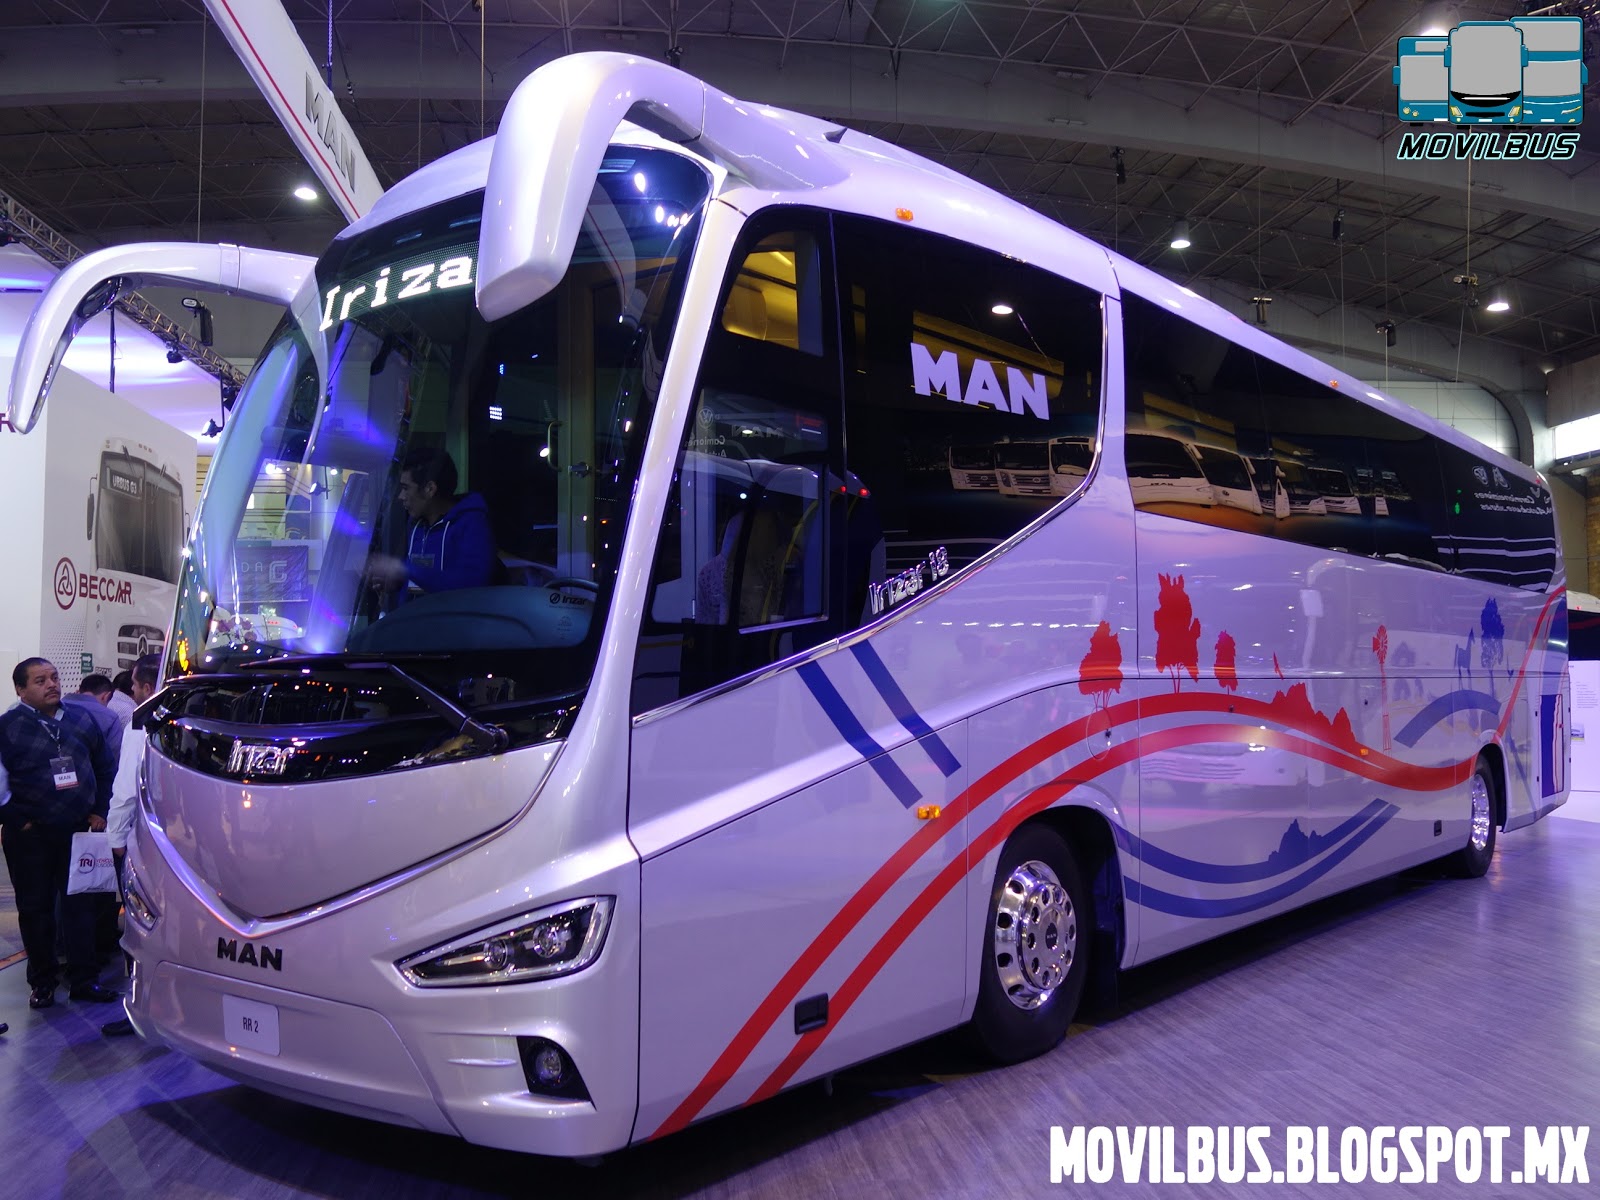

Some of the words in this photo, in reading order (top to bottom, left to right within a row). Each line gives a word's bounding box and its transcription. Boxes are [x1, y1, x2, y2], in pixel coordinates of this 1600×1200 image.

[306, 72, 355, 193] MAN
[910, 342, 1050, 420] MAN
[79, 573, 132, 605] BECCAR
[79, 858, 93, 868] TRI
[217, 937, 283, 971] MAN
[242, 1017, 253, 1032] RR
[254, 1020, 259, 1033] 2
